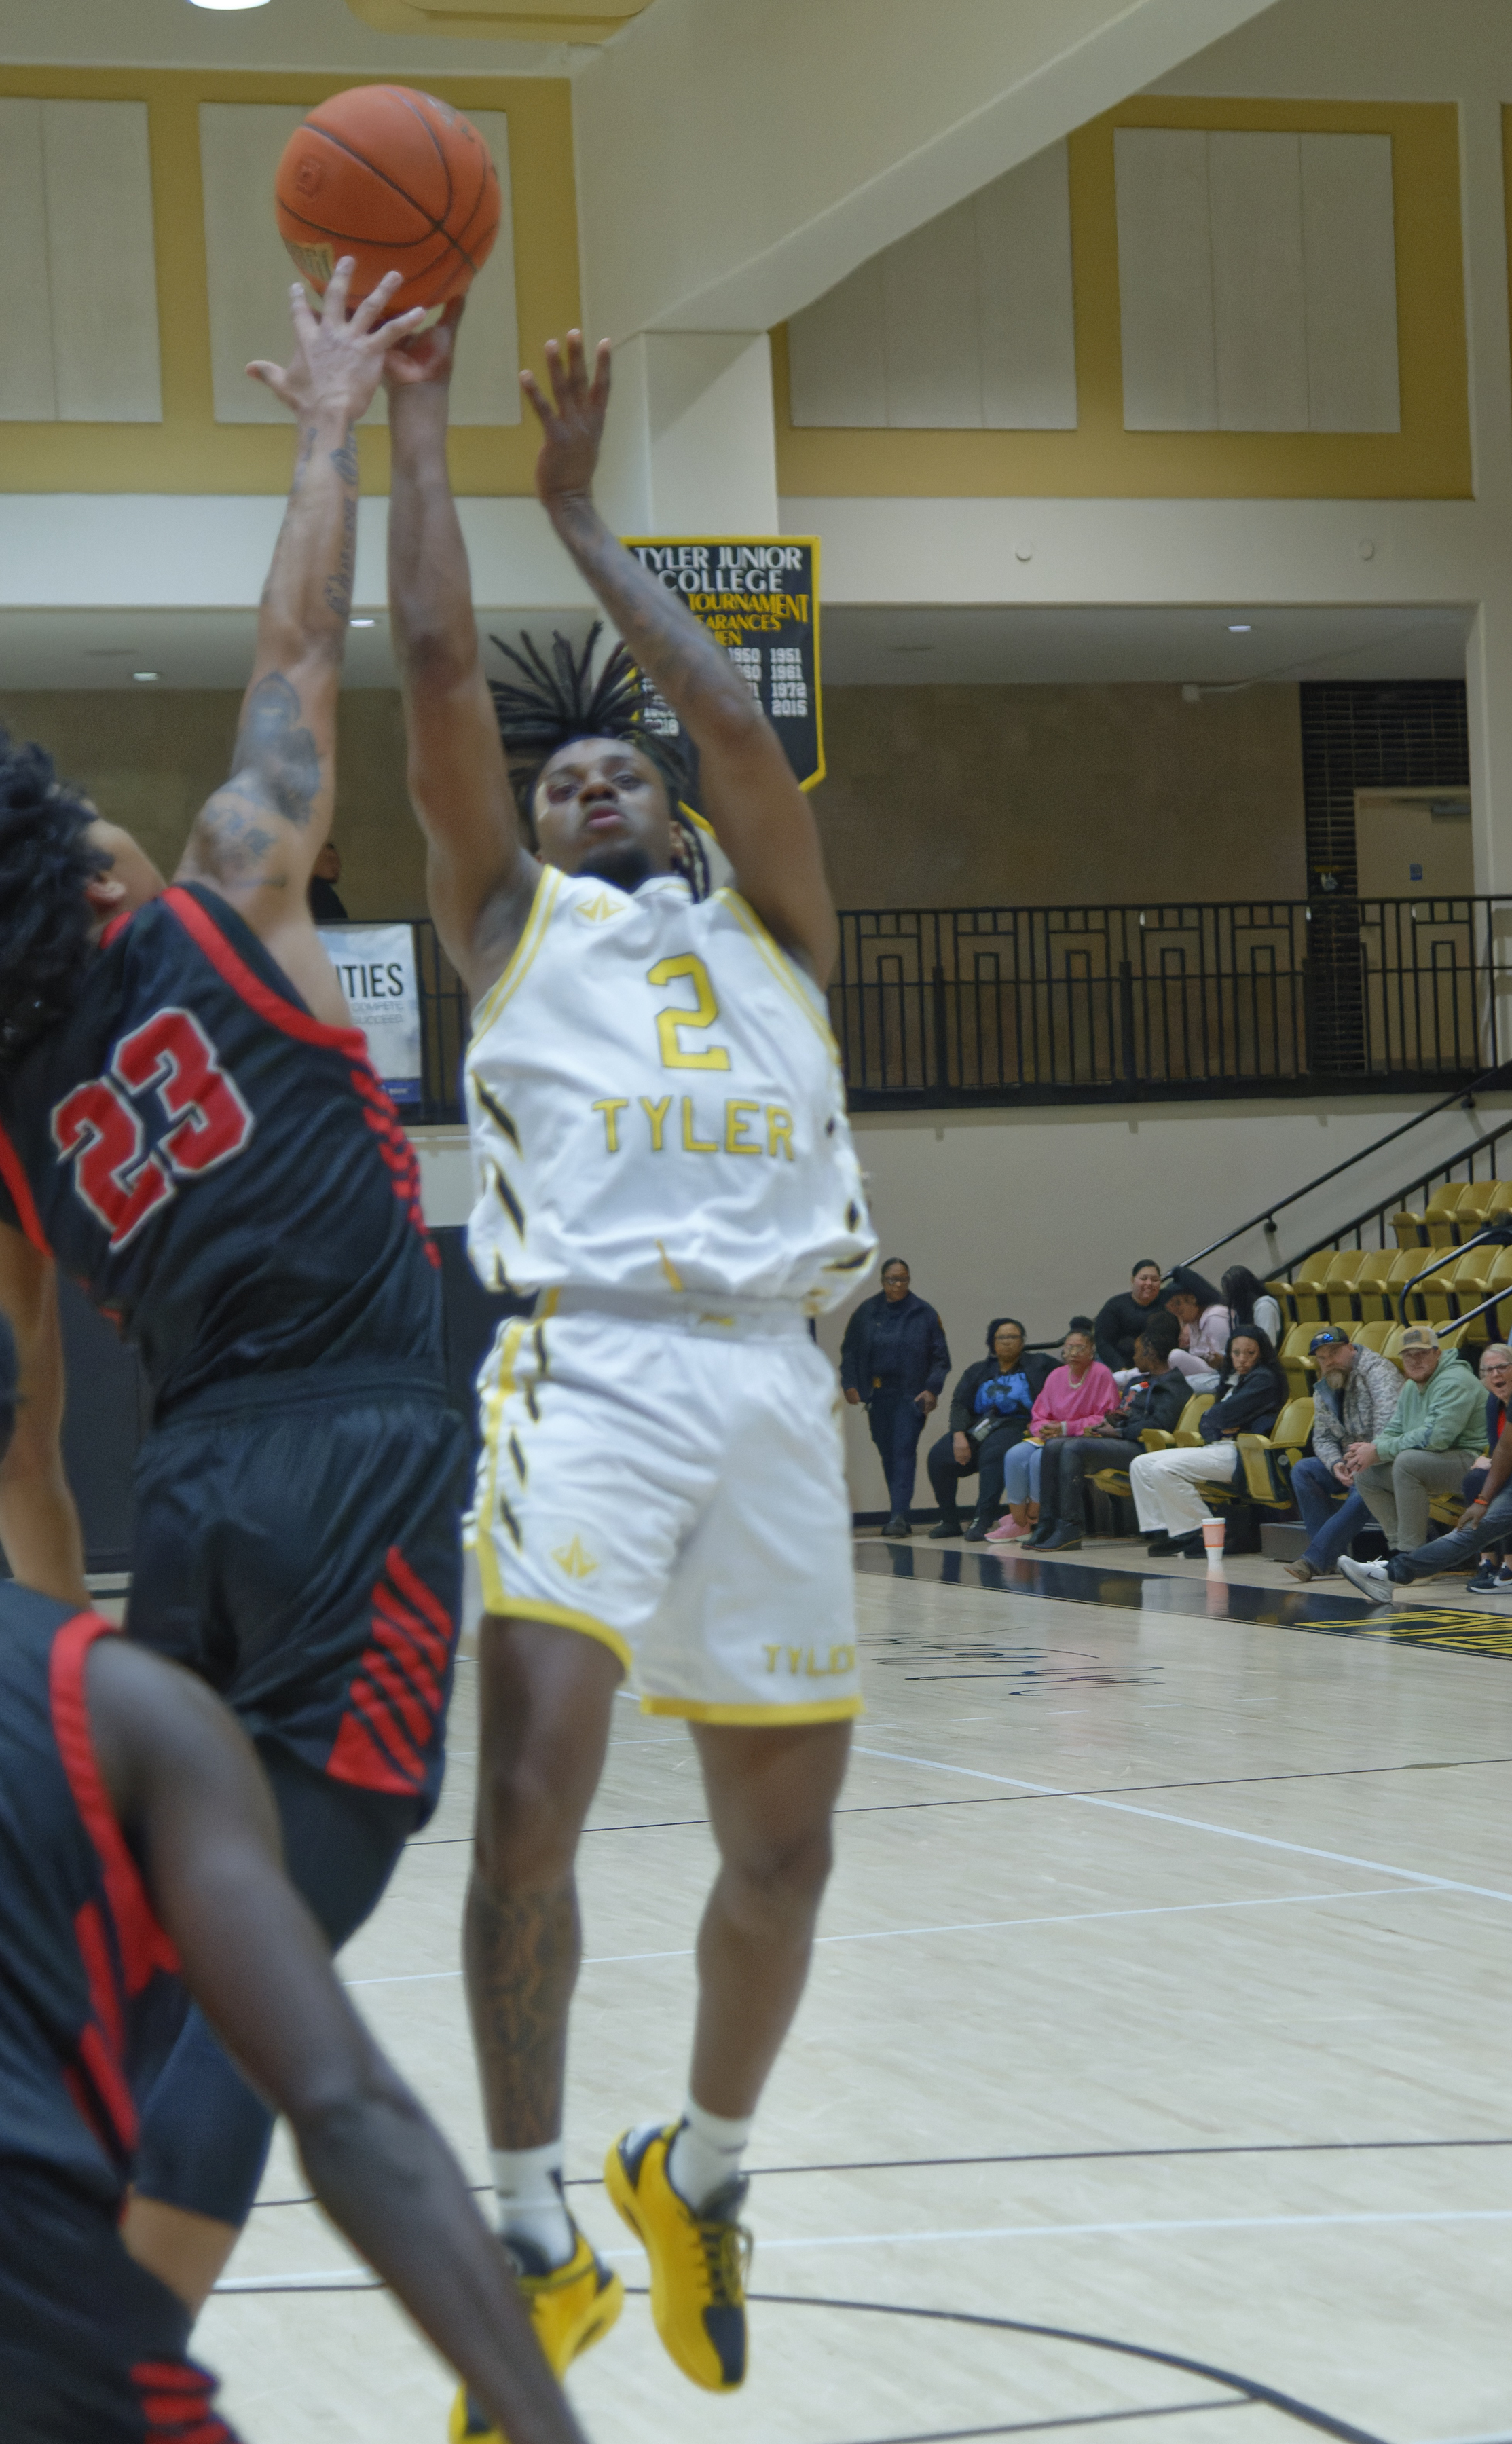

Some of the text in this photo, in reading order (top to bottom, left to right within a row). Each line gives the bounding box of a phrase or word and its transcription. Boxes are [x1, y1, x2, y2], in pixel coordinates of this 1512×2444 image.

[634, 546, 803, 571] TYLER JUNIOR
[658, 568, 783, 594] COLLEGE
[688, 593, 809, 624] TOURNAMENT
[770, 647, 802, 664] 1951
[771, 682, 807, 699] 1972
[771, 699, 807, 717] 2015
[647, 952, 731, 1071] 2
[50, 1007, 255, 1253] 23
[592, 1095, 794, 1162] TYLER
